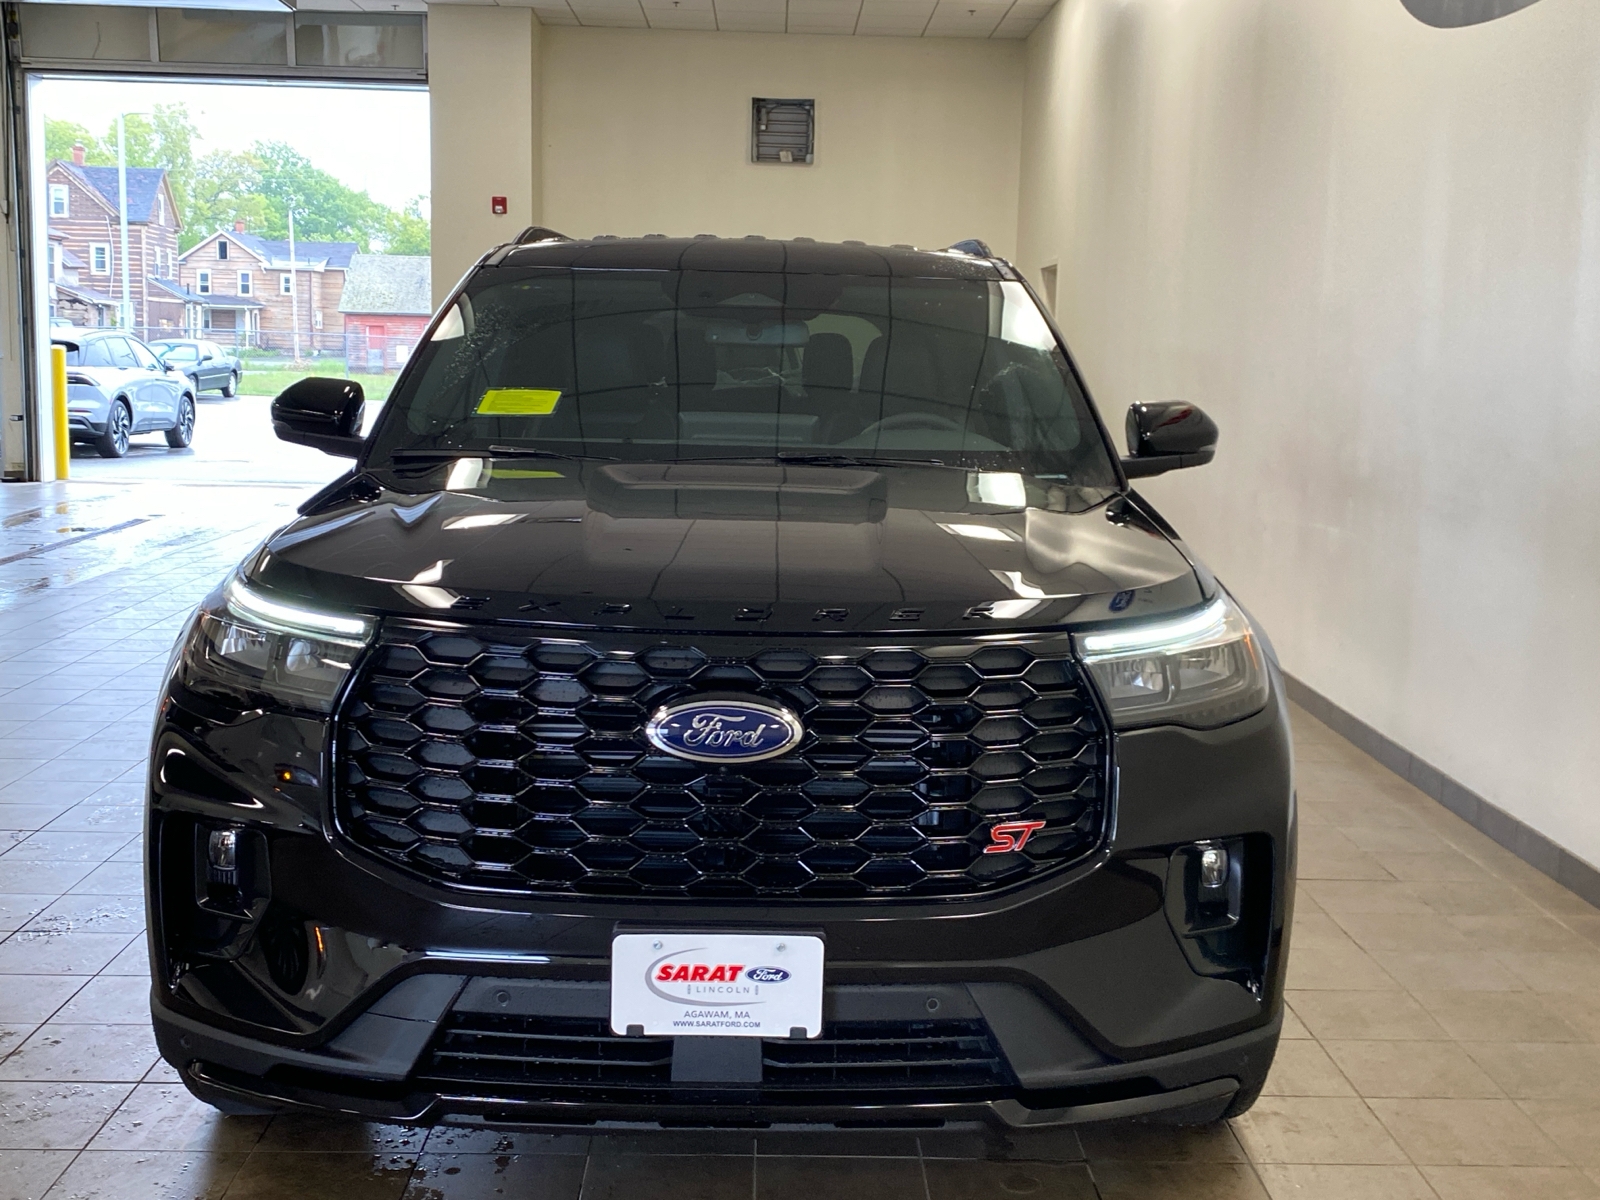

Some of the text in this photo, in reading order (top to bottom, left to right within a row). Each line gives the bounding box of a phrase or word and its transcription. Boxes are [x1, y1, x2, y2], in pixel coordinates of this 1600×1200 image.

[451, 596, 994, 622] EXPLORER
[683, 713, 766, 747] Ford
[983, 820, 1046, 853] ST
[655, 964, 783, 982] SARAT Ford
[696, 986, 750, 994] LINCOLN
[684, 1010, 751, 1019] AGAWAM, MA
[673, 1020, 761, 1028] WWW.SARATFORD.COM
